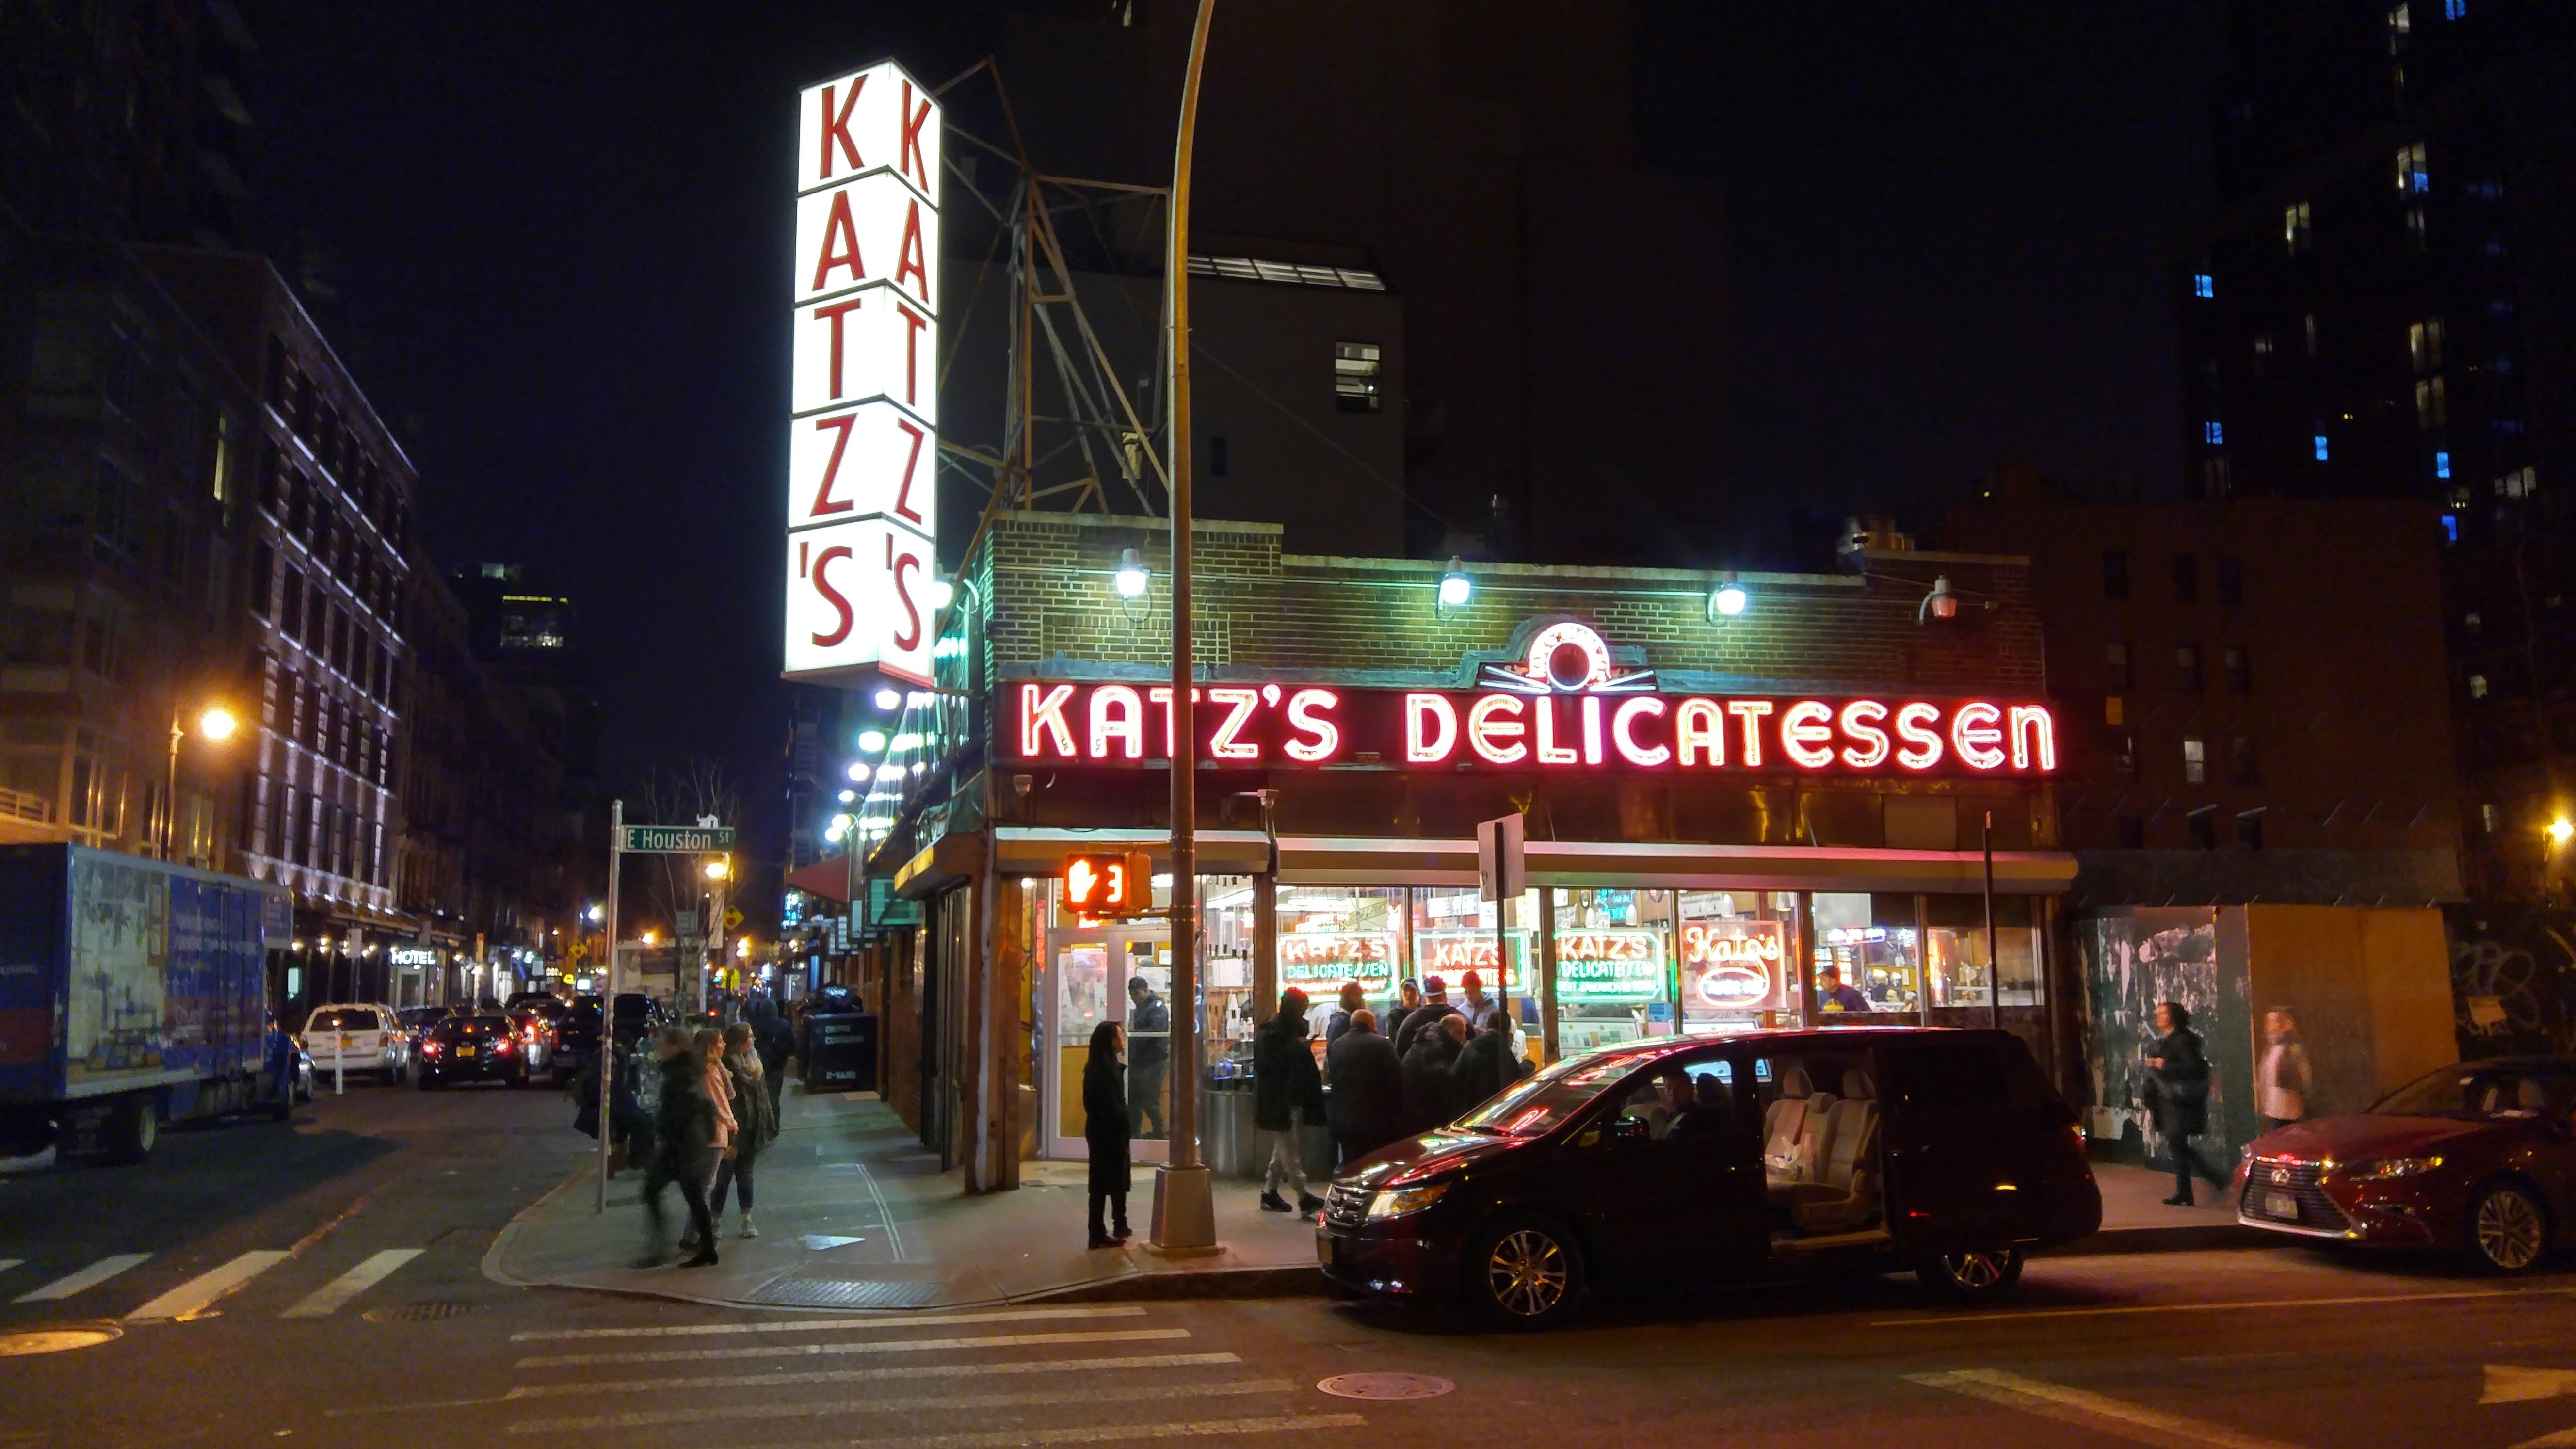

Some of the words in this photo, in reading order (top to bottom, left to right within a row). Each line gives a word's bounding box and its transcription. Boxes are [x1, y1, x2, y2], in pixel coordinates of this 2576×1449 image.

[800, 74, 868, 648] KATZ'S
[886, 79, 932, 652] KATZ'S
[1021, 684, 1338, 761] KATZ'S
[628, 829, 635, 849] E
[643, 829, 711, 850] Houston
[719, 831, 729, 844] St
[1106, 865, 1123, 902] 3
[391, 950, 436, 964] HOTEL
[1286, 939, 1385, 960] KATZS
[1561, 935, 1648, 960] KATZ'S
